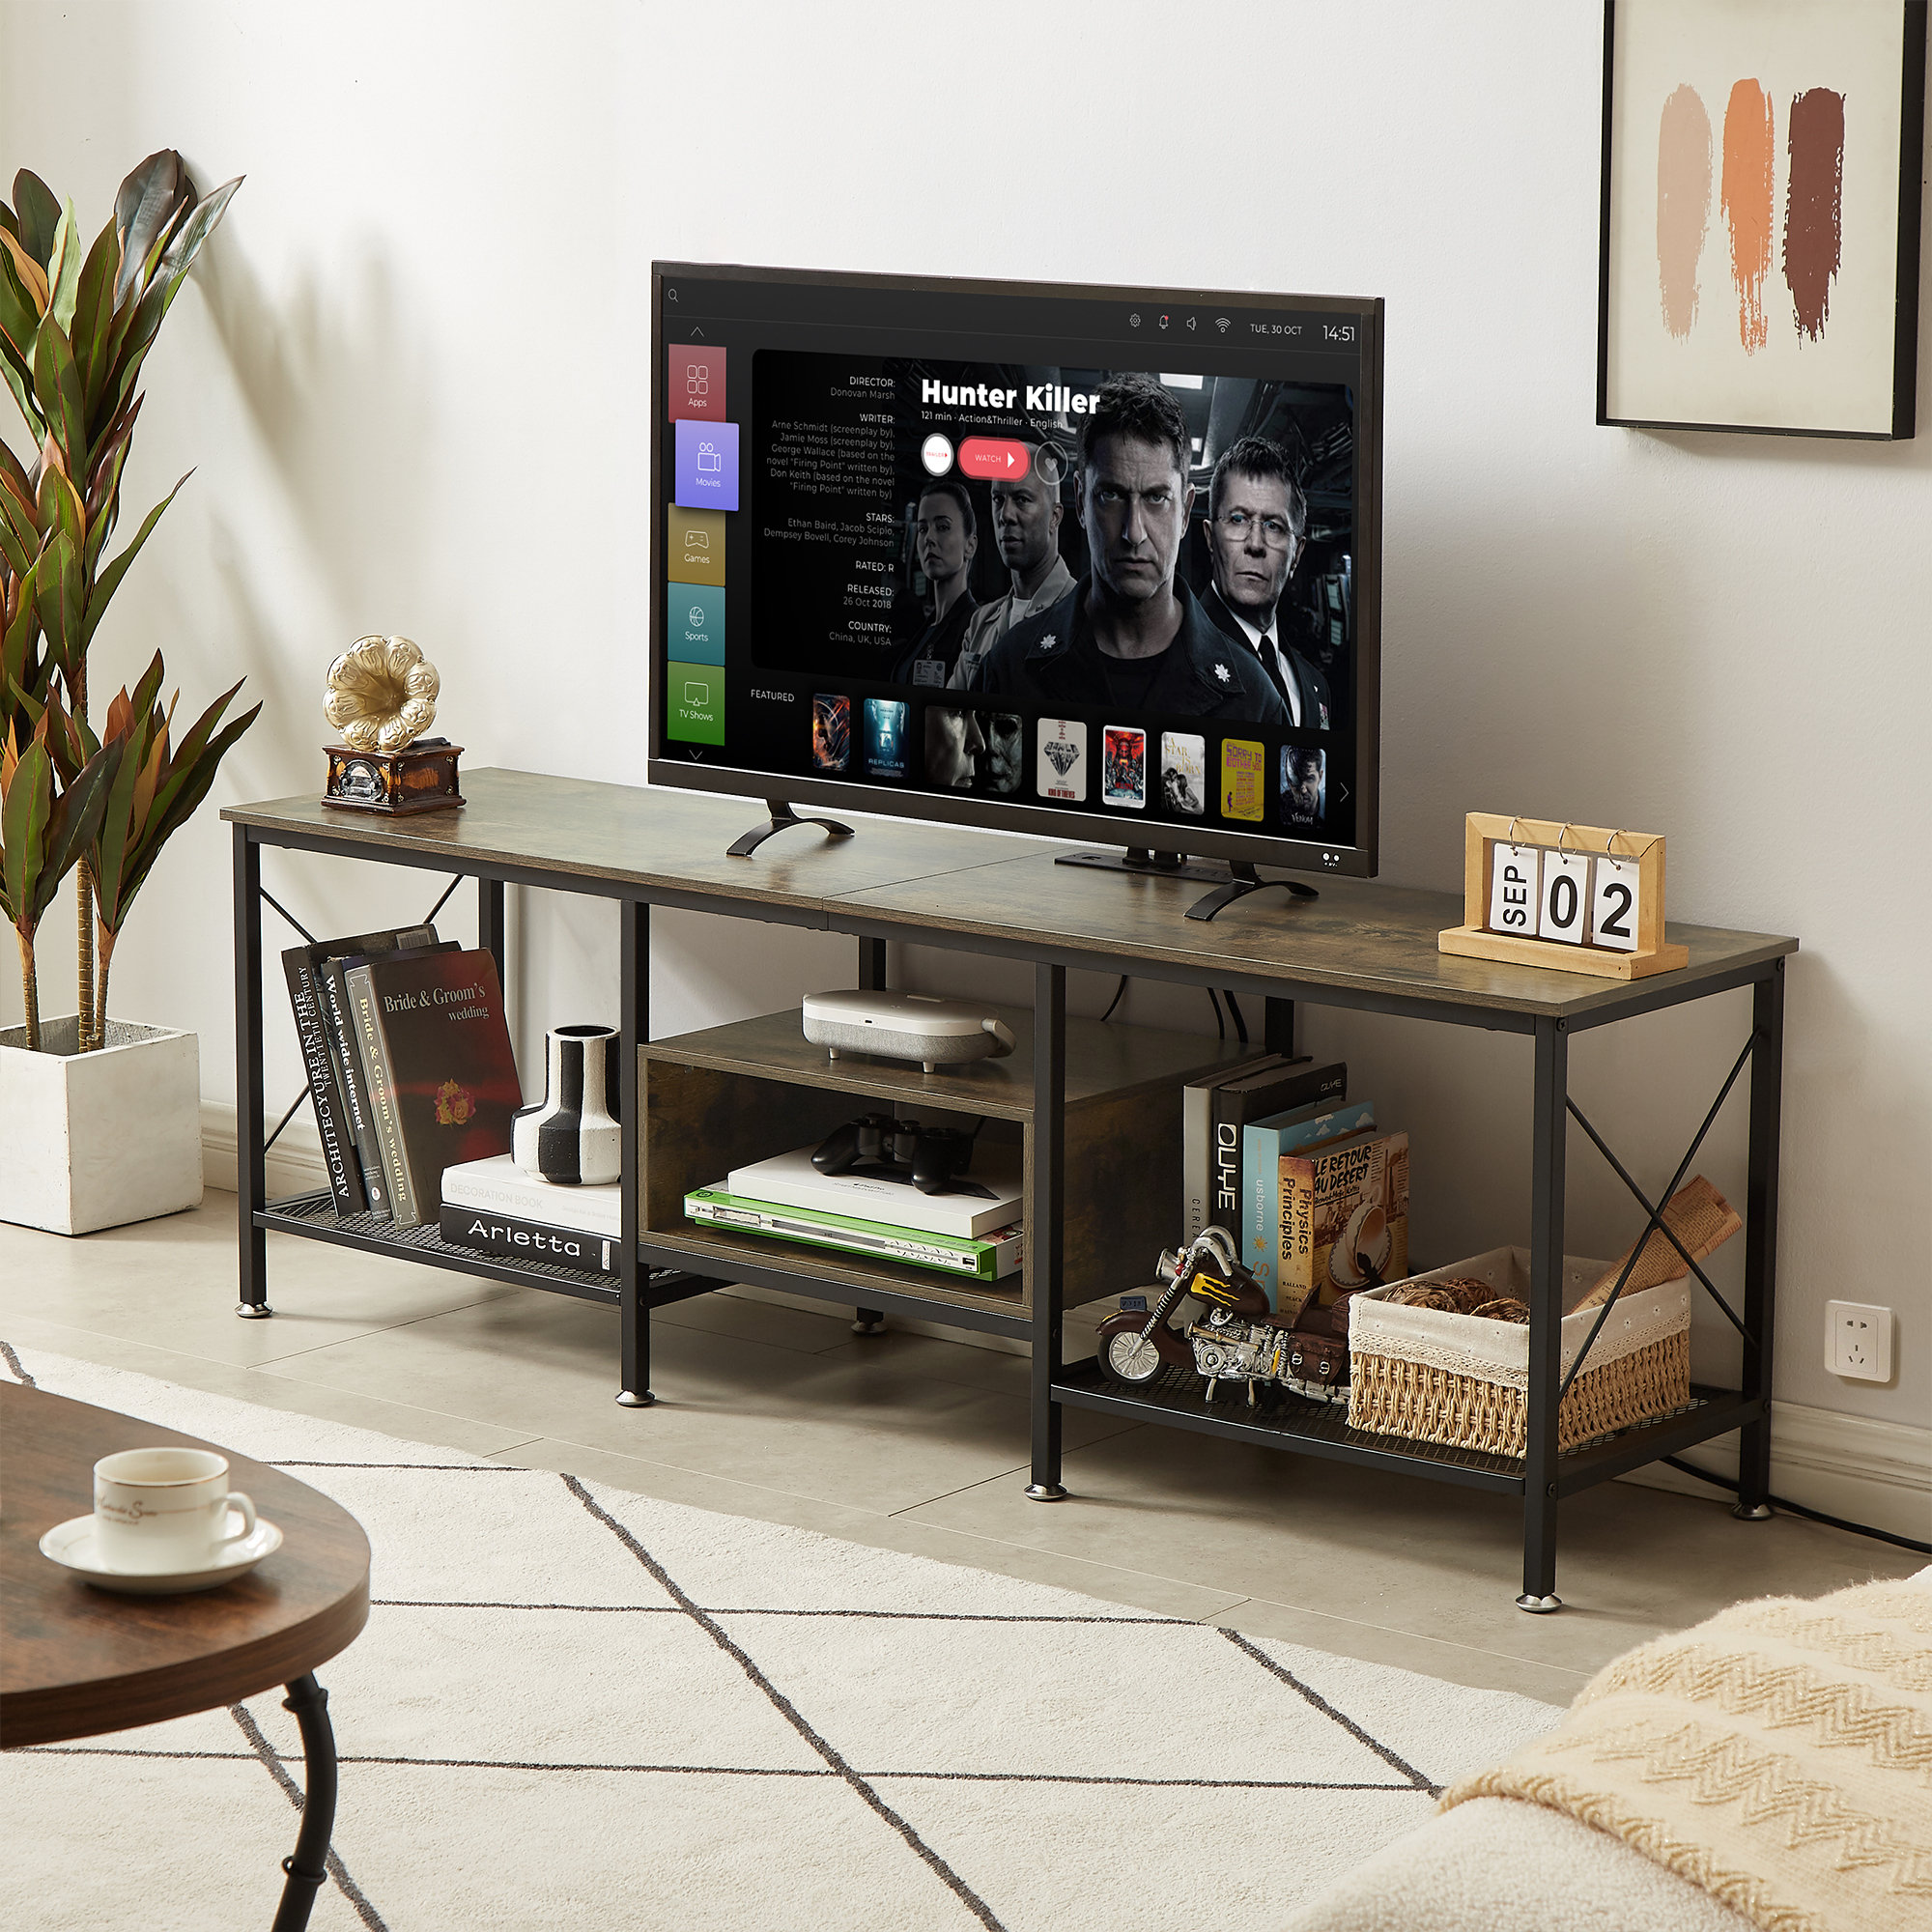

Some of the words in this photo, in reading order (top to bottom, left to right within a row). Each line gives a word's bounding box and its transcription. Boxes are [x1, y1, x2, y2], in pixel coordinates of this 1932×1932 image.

[1250, 324, 1269, 334] TUE,
[1271, 325, 1283, 335] 30
[1284, 326, 1302, 336] OCT
[1322, 325, 1355, 342] 14:51
[849, 376, 895, 387] DIRECTOR:
[831, 387, 867, 398] Donovan
[869, 390, 895, 400] Marsh
[922, 379, 1017, 410] Hunter
[1026, 383, 1100, 414] Killer
[688, 398, 707, 408] Apps
[859, 412, 895, 424] WRITER:
[921, 411, 933, 420] 121
[935, 412, 952, 421] min
[958, 413, 1023, 426] Action&Thriller
[1030, 417, 1063, 430] English
[772, 420, 791, 430] Arne
[794, 421, 828, 432] Schmidt
[831, 425, 877, 438] (screenplay
[781, 432, 805, 442] Jamie
[808, 435, 828, 444] Moss
[831, 437, 877, 449] (screenplay
[772, 444, 801, 455] George
[804, 446, 836, 457] Wallace
[838, 448, 866, 459] (based
[881, 452, 895, 462] the
[975, 454, 1002, 463] WATCH
[766, 457, 788, 466] novel
[847, 463, 877, 472] written
[696, 477, 721, 488] Movies
[770, 468, 786, 477] Don
[789, 469, 810, 479] Keith
[813, 471, 840, 482] (based
[842, 474, 853, 483] on
[856, 475, 869, 484] the
[872, 477, 895, 486] novel
[846, 487, 877, 497] written
[787, 518, 812, 528] Ethan
[814, 520, 838, 531] Baird,
[840, 523, 865, 533] Jacob
[866, 512, 895, 524] STARS:
[764, 527, 802, 541] Dempsey
[804, 531, 831, 543] Bovell,
[833, 533, 857, 546] Corey
[859, 536, 895, 548] Johnson
[684, 554, 710, 564] Games
[855, 560, 887, 572] RATED:
[888, 563, 895, 572] R
[847, 583, 895, 597] RELEASED:
[842, 596, 854, 606] 26
[855, 597, 870, 608] Oct
[872, 599, 892, 610] 2018
[848, 620, 892, 634] COUNTRY:
[685, 631, 709, 642] Sports
[829, 631, 855, 643] China,
[857, 635, 872, 645] UK,
[874, 636, 892, 646] USA
[751, 689, 795, 702] FEATURED
[679, 709, 689, 719] TV
[690, 710, 714, 722] Shows
[1227, 743, 1252, 761] SORRY
[868, 758, 904, 769] REPLICAS
[1503, 865, 1527, 926] SEP
[298, 967, 317, 1017] CENTURY
[384, 991, 417, 1013] Bride
[419, 989, 431, 1008] &
[294, 992, 311, 1032] THE
[448, 1006, 490, 1021] wedding
[303, 1034, 317, 1055] IN
[326, 975, 343, 1027] World
[337, 1029, 351, 1066] wide
[345, 1068, 366, 1131] internet
[359, 998, 374, 1041] Bride
[370, 1045, 379, 1060] &
[389, 1138, 407, 1202] wedding
[1315, 1158, 1327, 1178] LE
[1329, 1146, 1372, 1173] RETOUR
[1315, 1178, 1328, 1194] AU
[1329, 1163, 1369, 1191] DESERT
[450, 1182, 513, 1204] DECORATION
[515, 1195, 544, 1209] BOOK
[1256, 1179, 1264, 1232] usborne
[1280, 1178, 1295, 1261] Principles
[1296, 1188, 1312, 1255] Physics
[468, 1219, 581, 1257] Arletta
